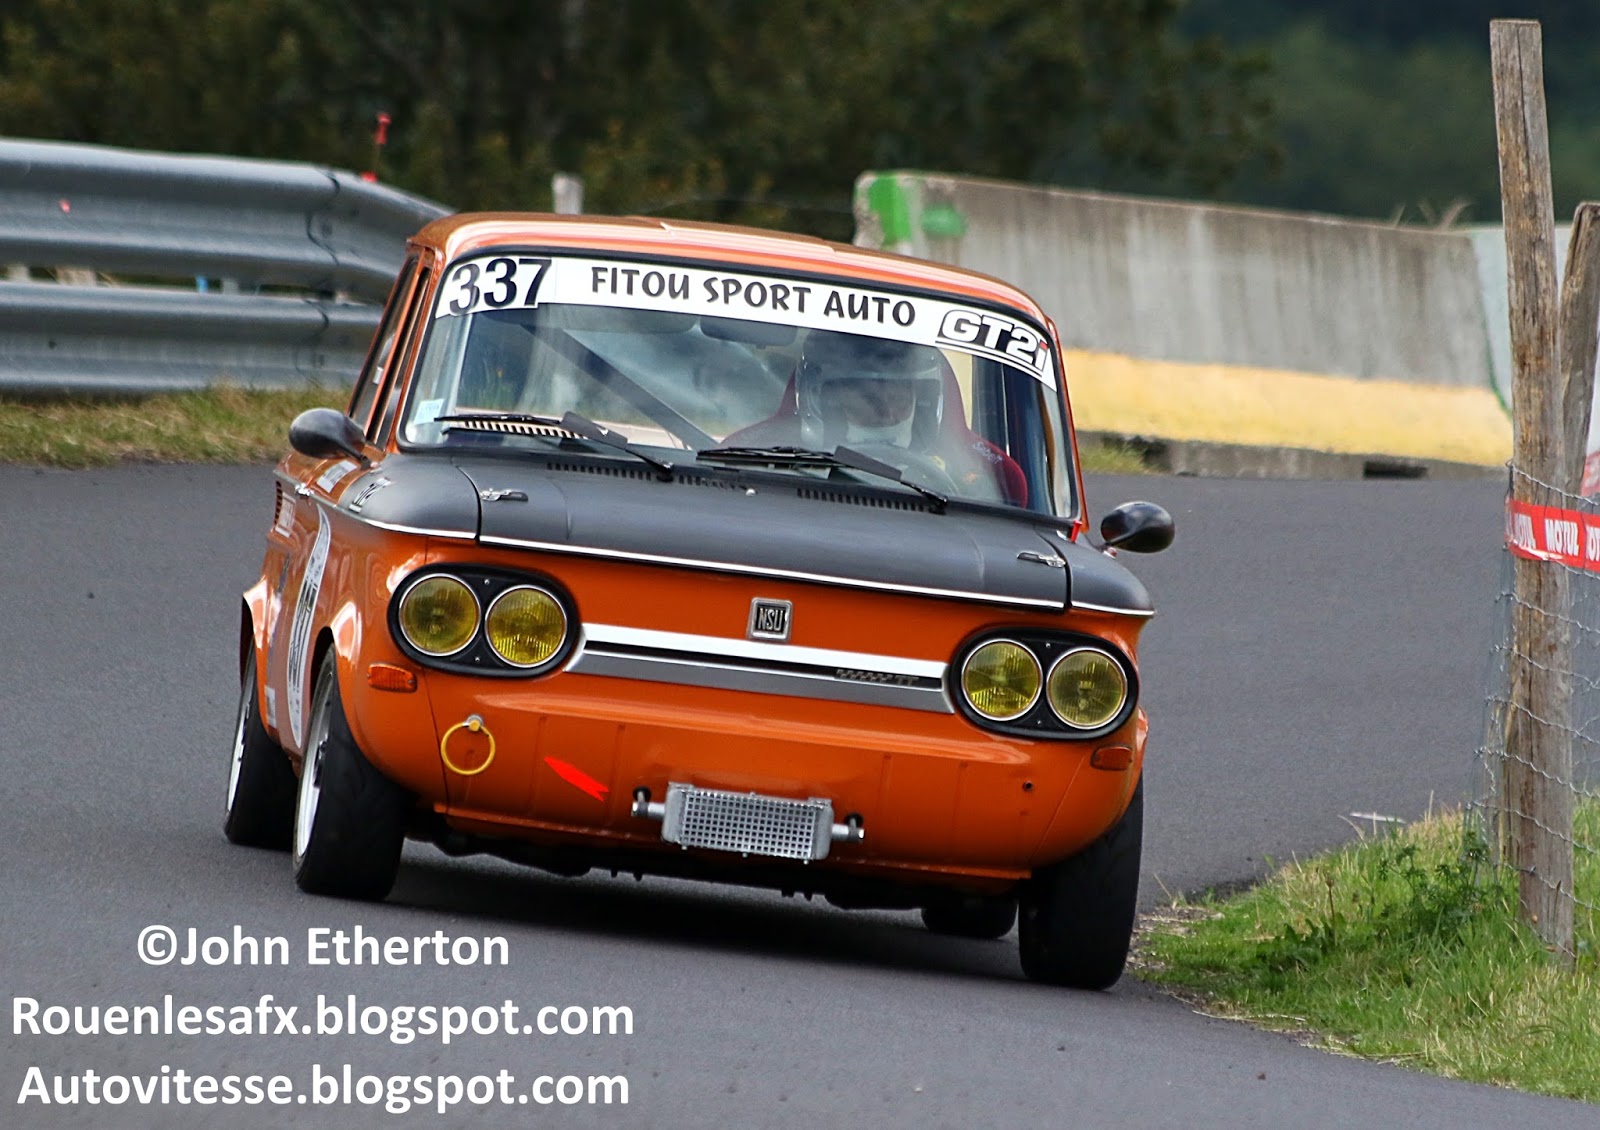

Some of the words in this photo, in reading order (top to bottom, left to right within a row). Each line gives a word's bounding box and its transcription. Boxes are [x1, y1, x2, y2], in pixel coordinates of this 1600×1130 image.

[448, 257, 552, 315] 337
[590, 265, 690, 300] FITOU
[704, 276, 807, 312] SPORT
[823, 290, 916, 327] AUTO
[1544, 518, 1579, 556] MOTUL
[757, 606, 784, 631] NSU
